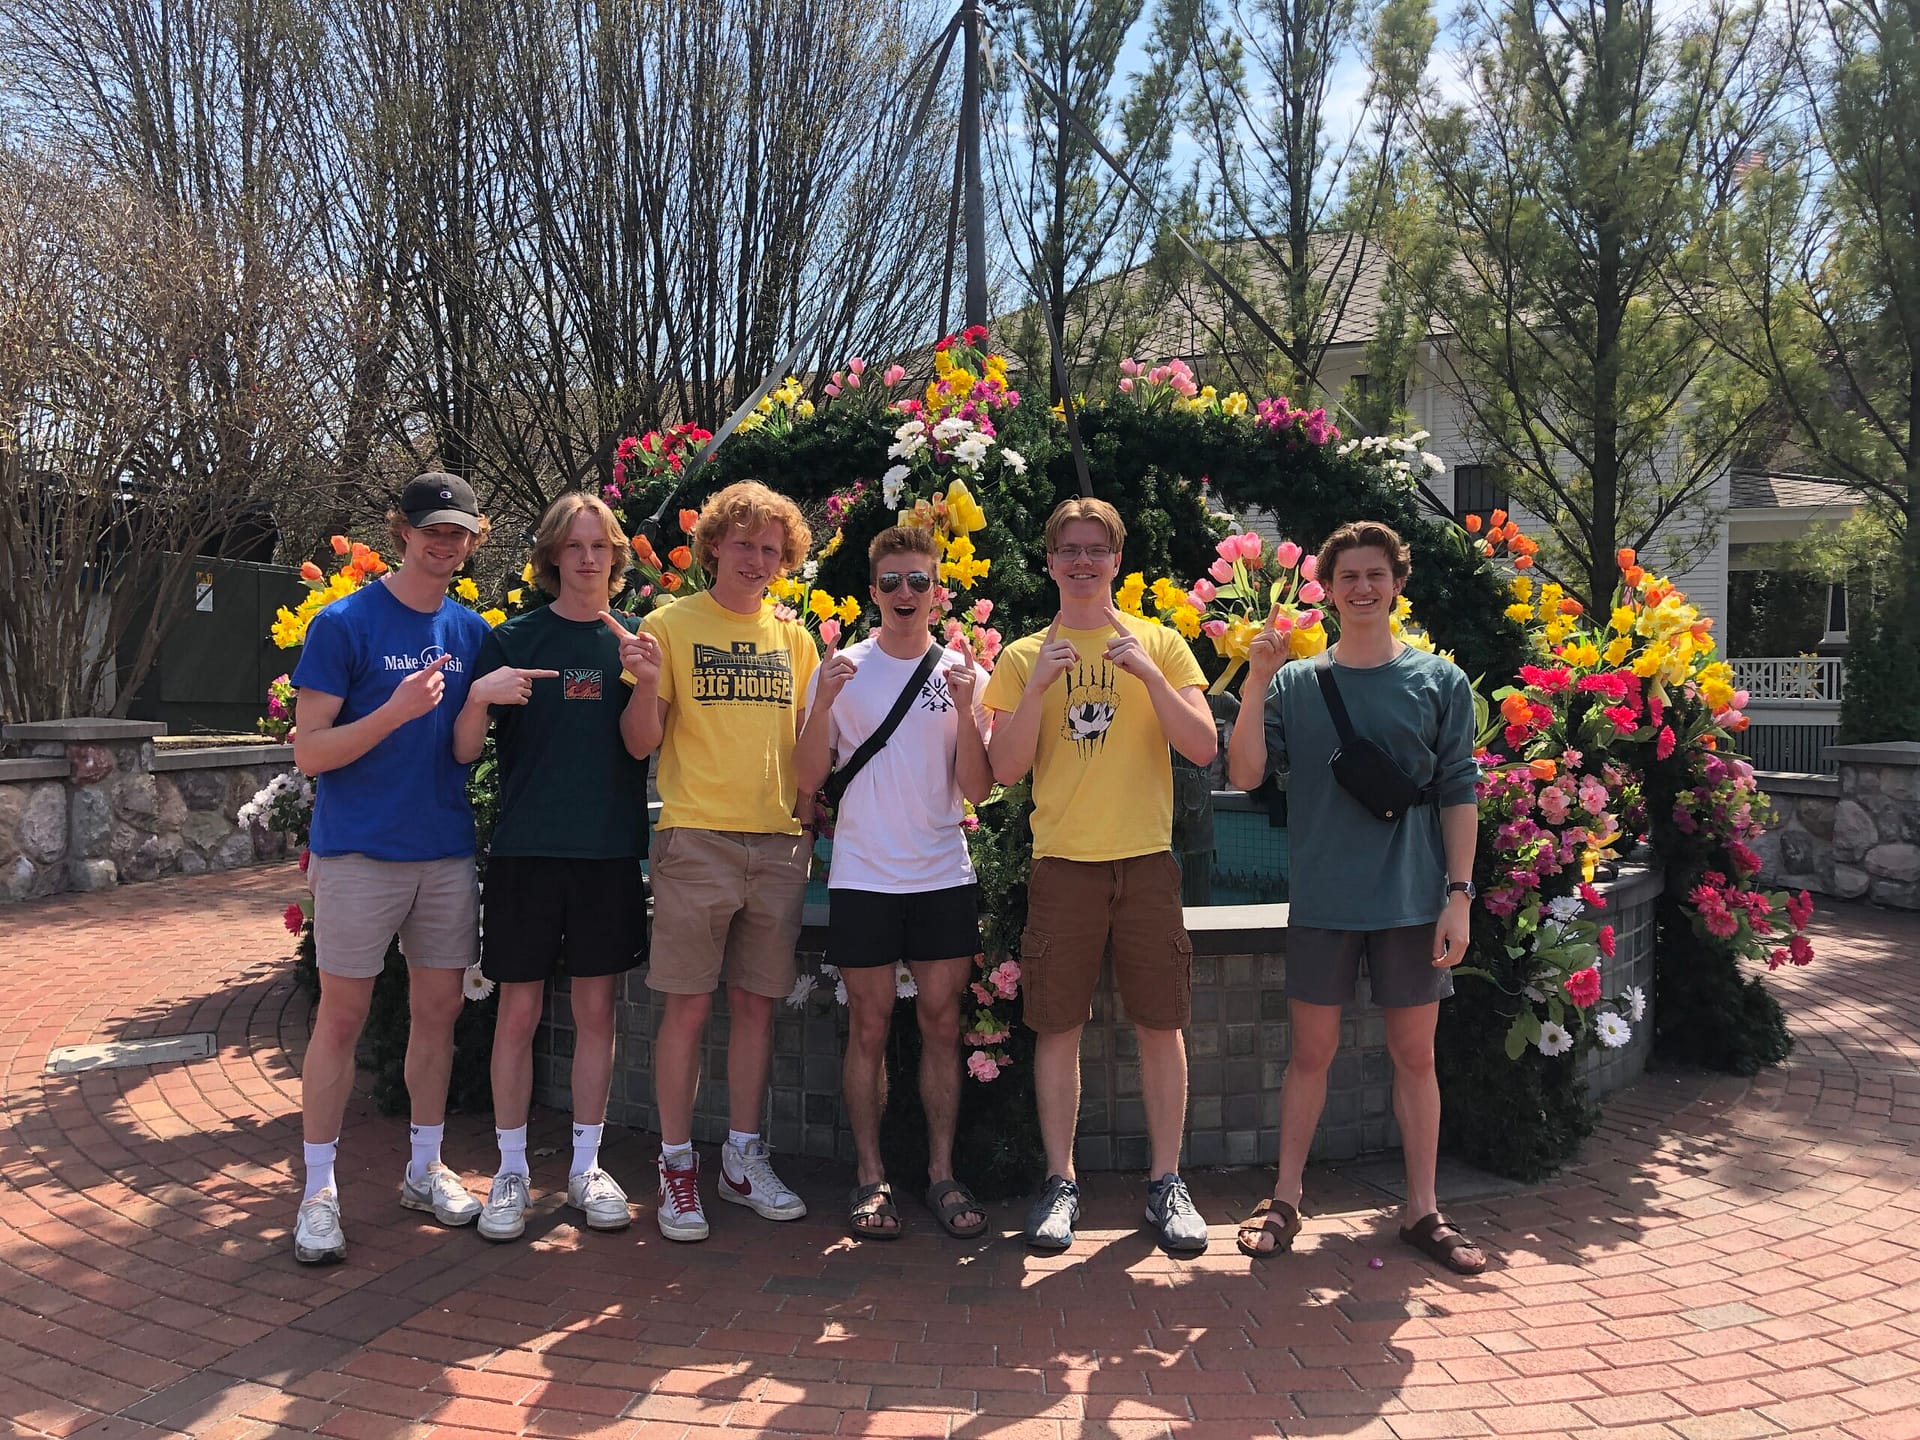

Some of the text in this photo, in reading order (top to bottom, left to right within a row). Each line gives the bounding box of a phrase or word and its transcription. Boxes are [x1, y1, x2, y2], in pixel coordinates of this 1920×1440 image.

[738, 643, 751, 653] M
[693, 667, 737, 676] BACK
[763, 670, 791, 680] THE
[692, 675, 792, 700] BIG HOUSE
